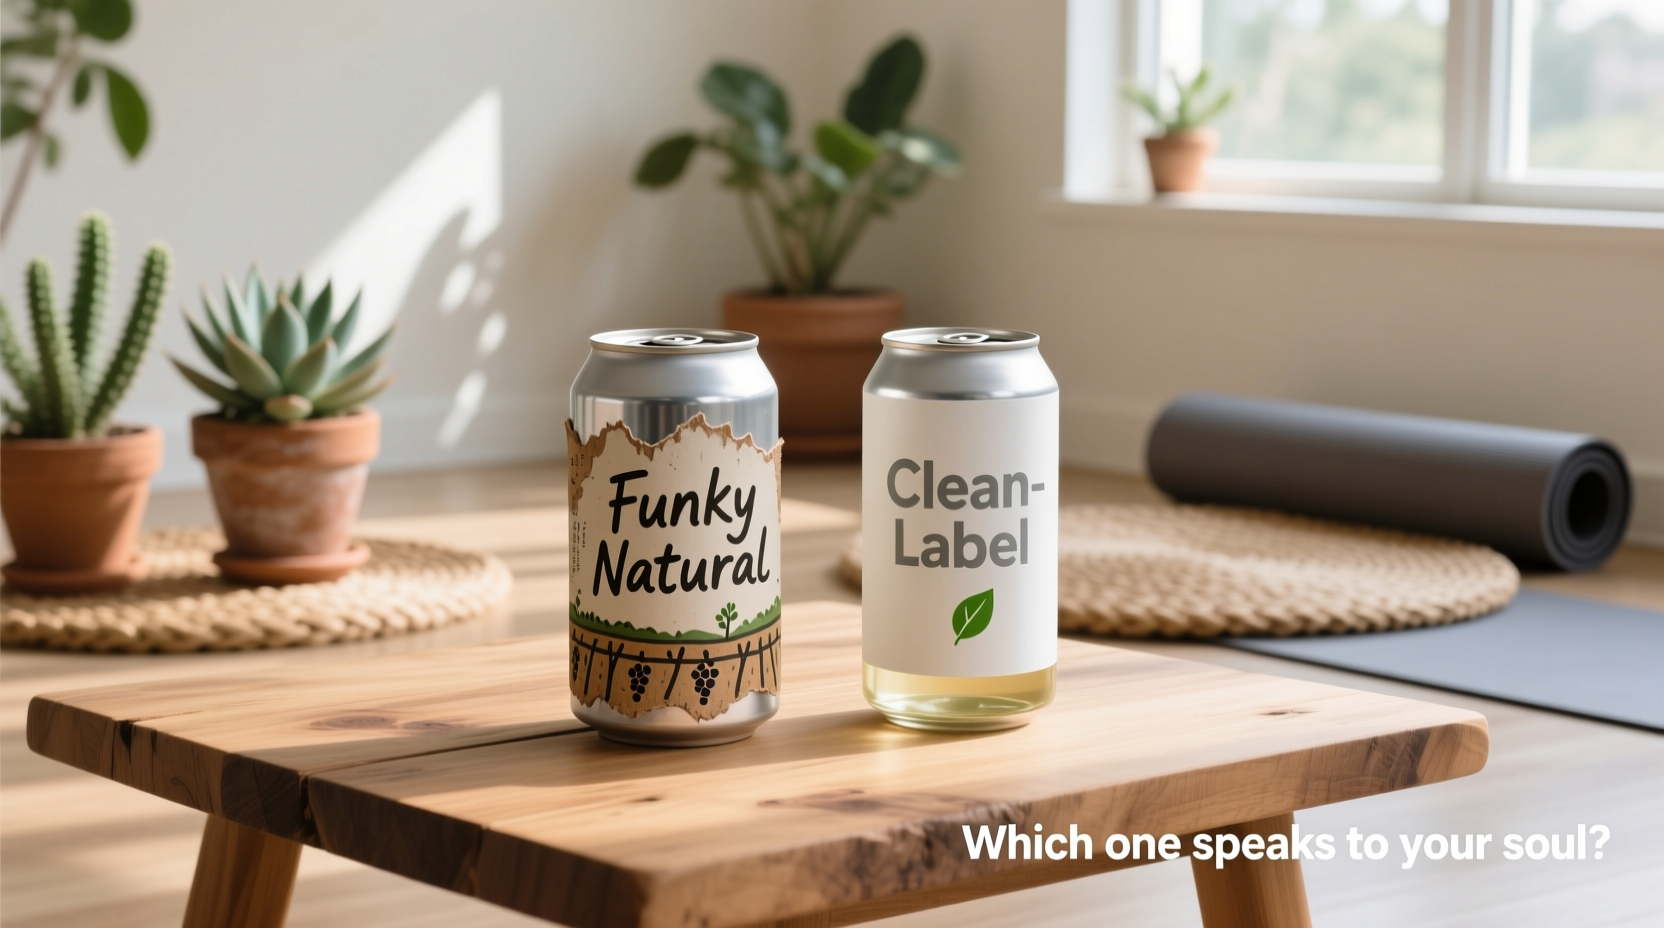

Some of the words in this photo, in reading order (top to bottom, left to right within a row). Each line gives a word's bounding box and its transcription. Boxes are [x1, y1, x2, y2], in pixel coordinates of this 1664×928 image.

[608, 466, 756, 545] Funky
[886, 458, 1045, 511] Clean-
[592, 525, 771, 597] Natural
[894, 517, 1029, 569] Label
